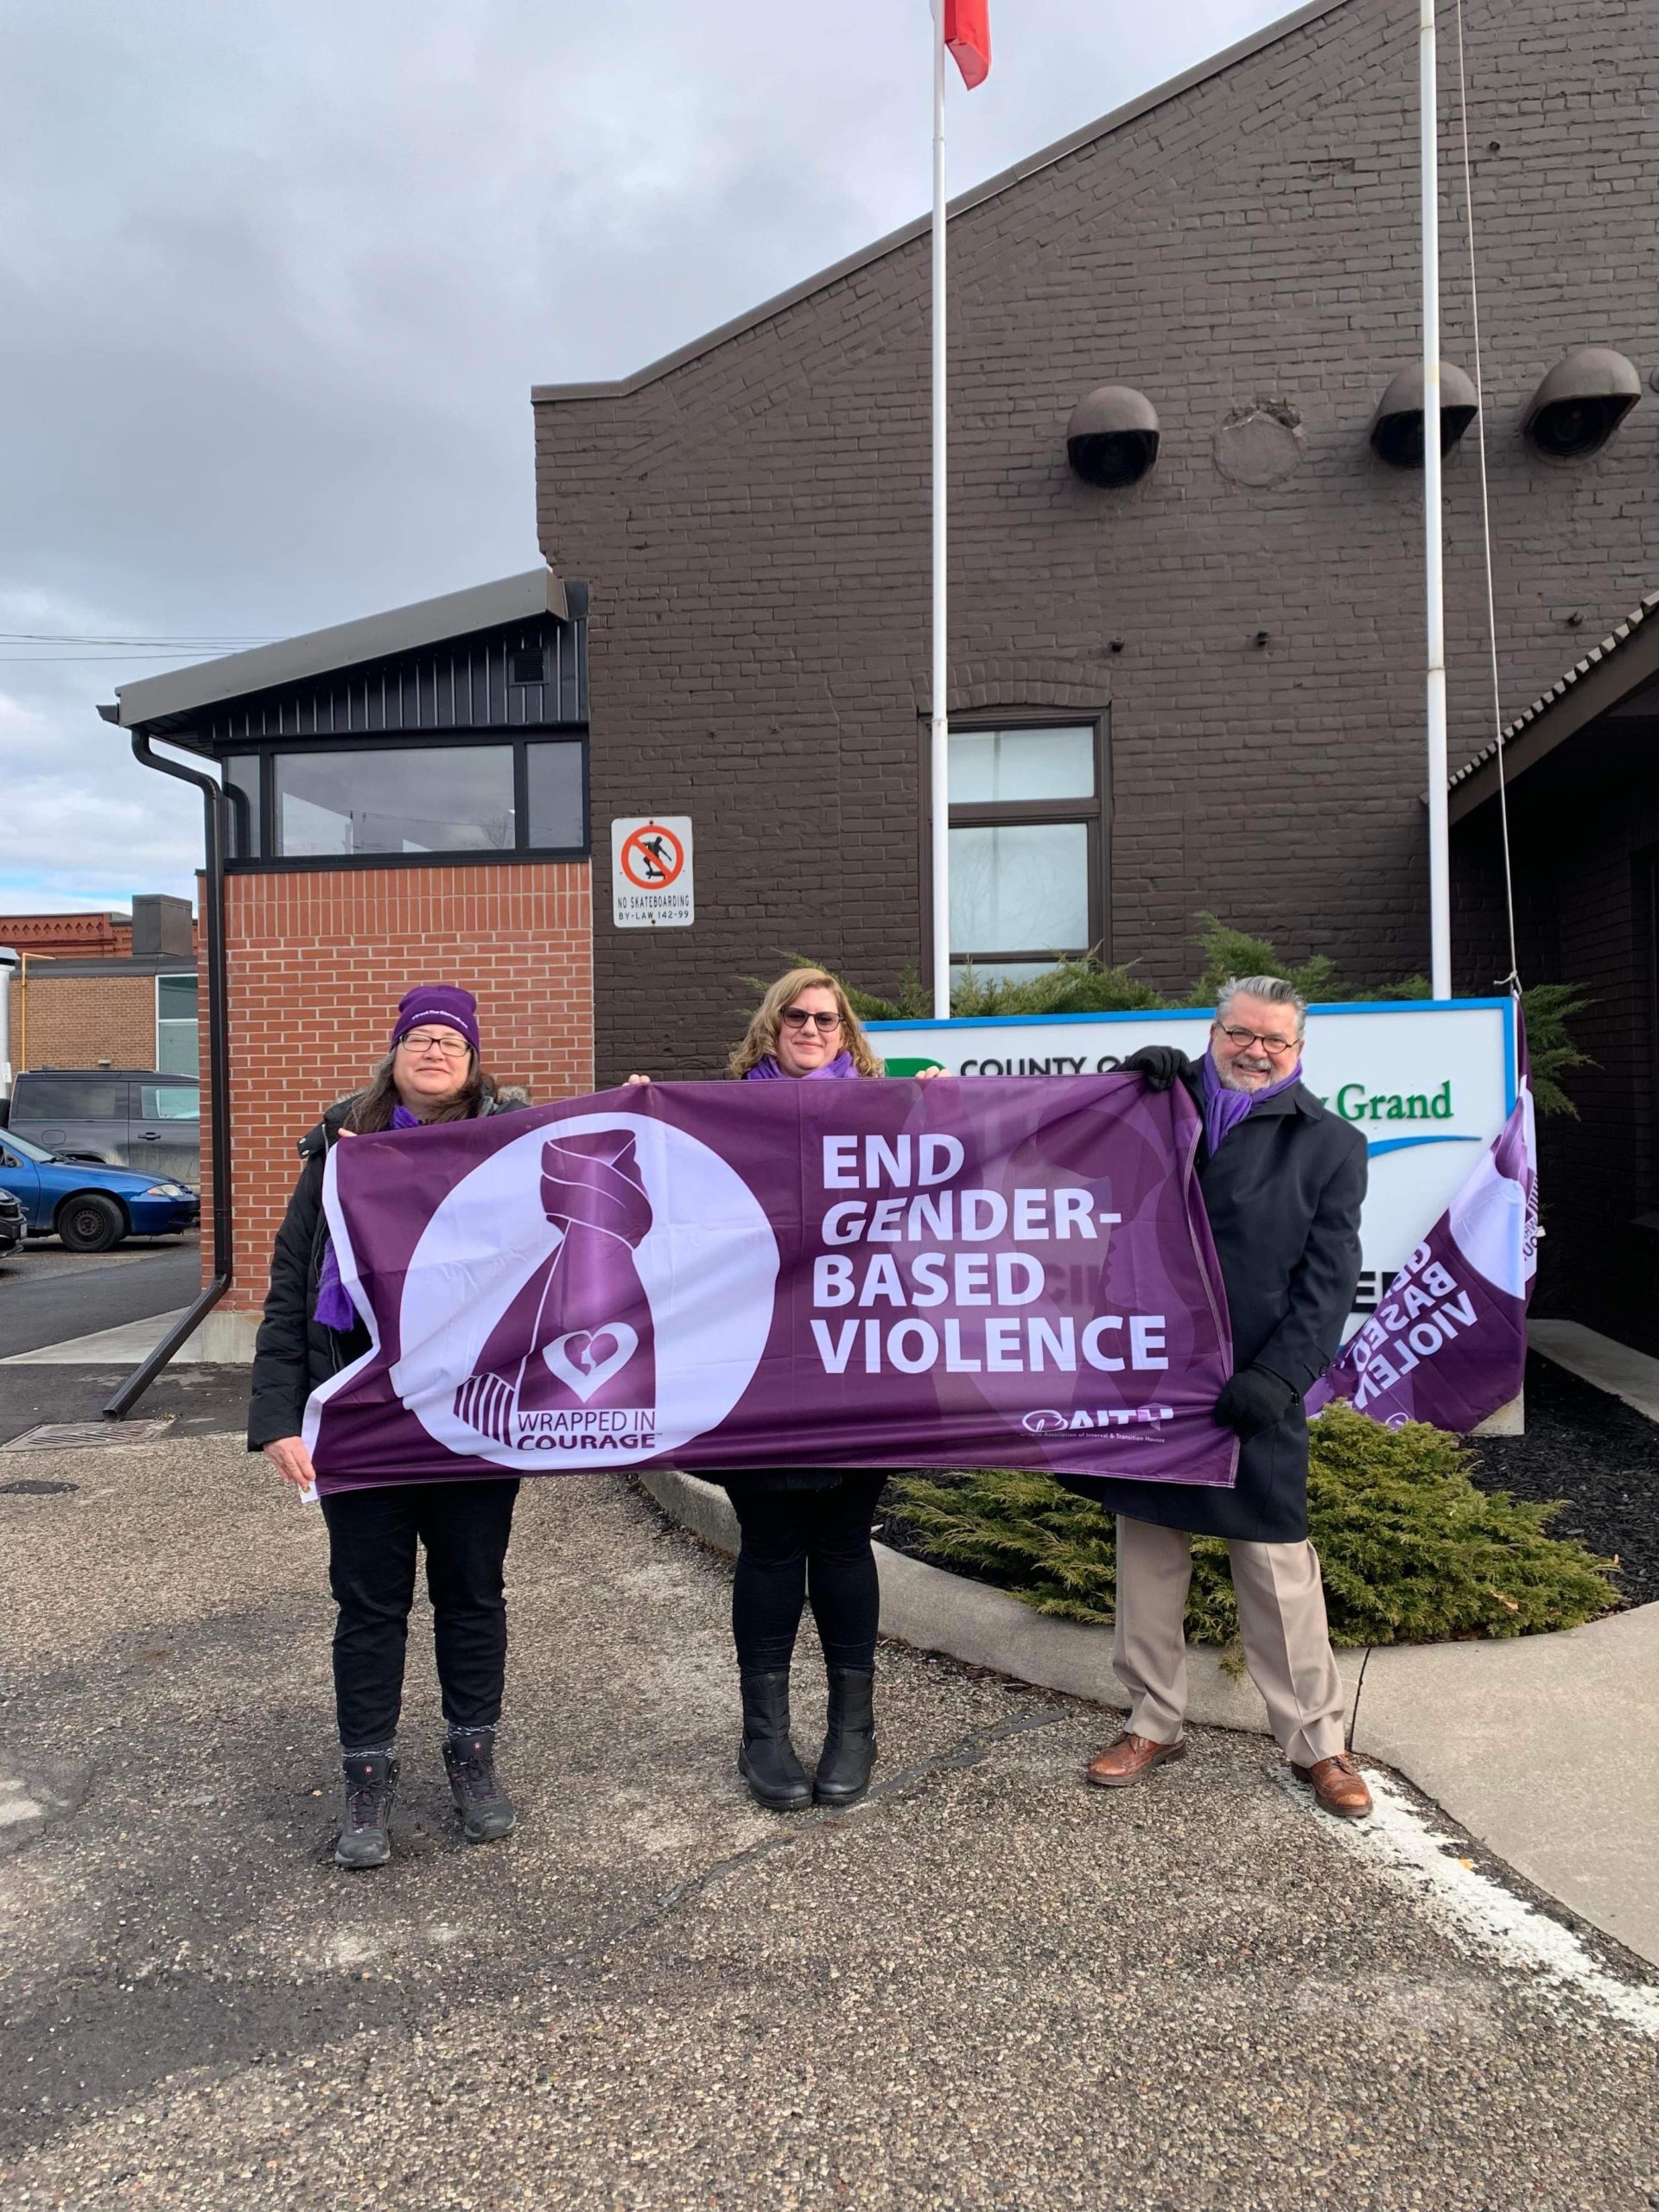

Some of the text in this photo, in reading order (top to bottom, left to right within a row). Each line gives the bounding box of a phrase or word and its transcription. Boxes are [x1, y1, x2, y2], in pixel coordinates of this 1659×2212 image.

[618, 895, 690, 908] NO SKATEBOARDING
[619, 910, 689, 920] BY-LAW 142-99
[960, 1056, 1087, 1076] COUNTY
[1337, 1079, 1453, 1121] Grand
[823, 1134, 964, 1189] END
[822, 1188, 1122, 1245] GENDER-
[813, 1252, 1045, 1307] BASED
[810, 1315, 1169, 1375] VIOLENCE
[518, 1411, 656, 1432] WRAPPED IN
[517, 1433, 656, 1451] COURAGE
